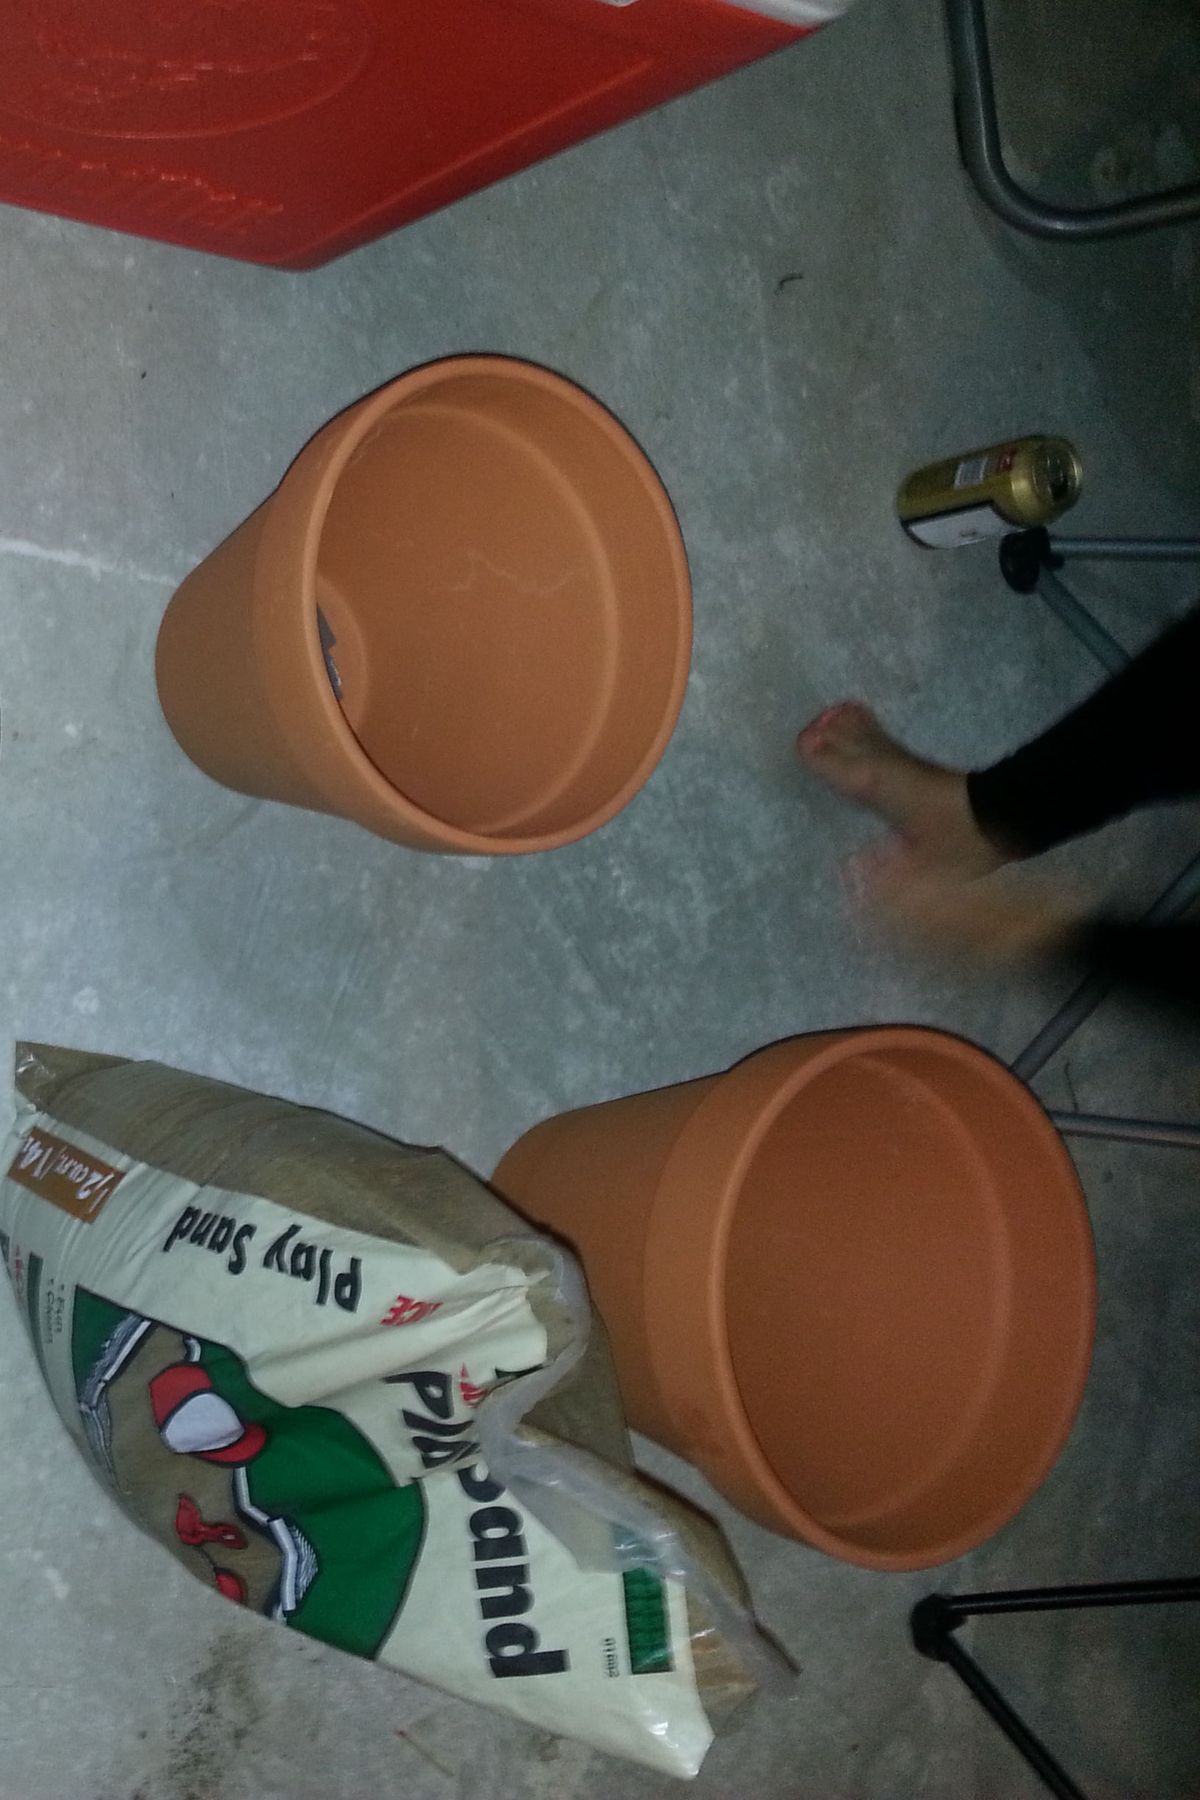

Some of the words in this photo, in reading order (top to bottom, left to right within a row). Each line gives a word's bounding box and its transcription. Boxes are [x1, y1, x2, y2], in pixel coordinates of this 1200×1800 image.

[163, 1206, 257, 1276] Sand
[262, 1224, 363, 1312] Play
[382, 1370, 484, 1470] Pla
